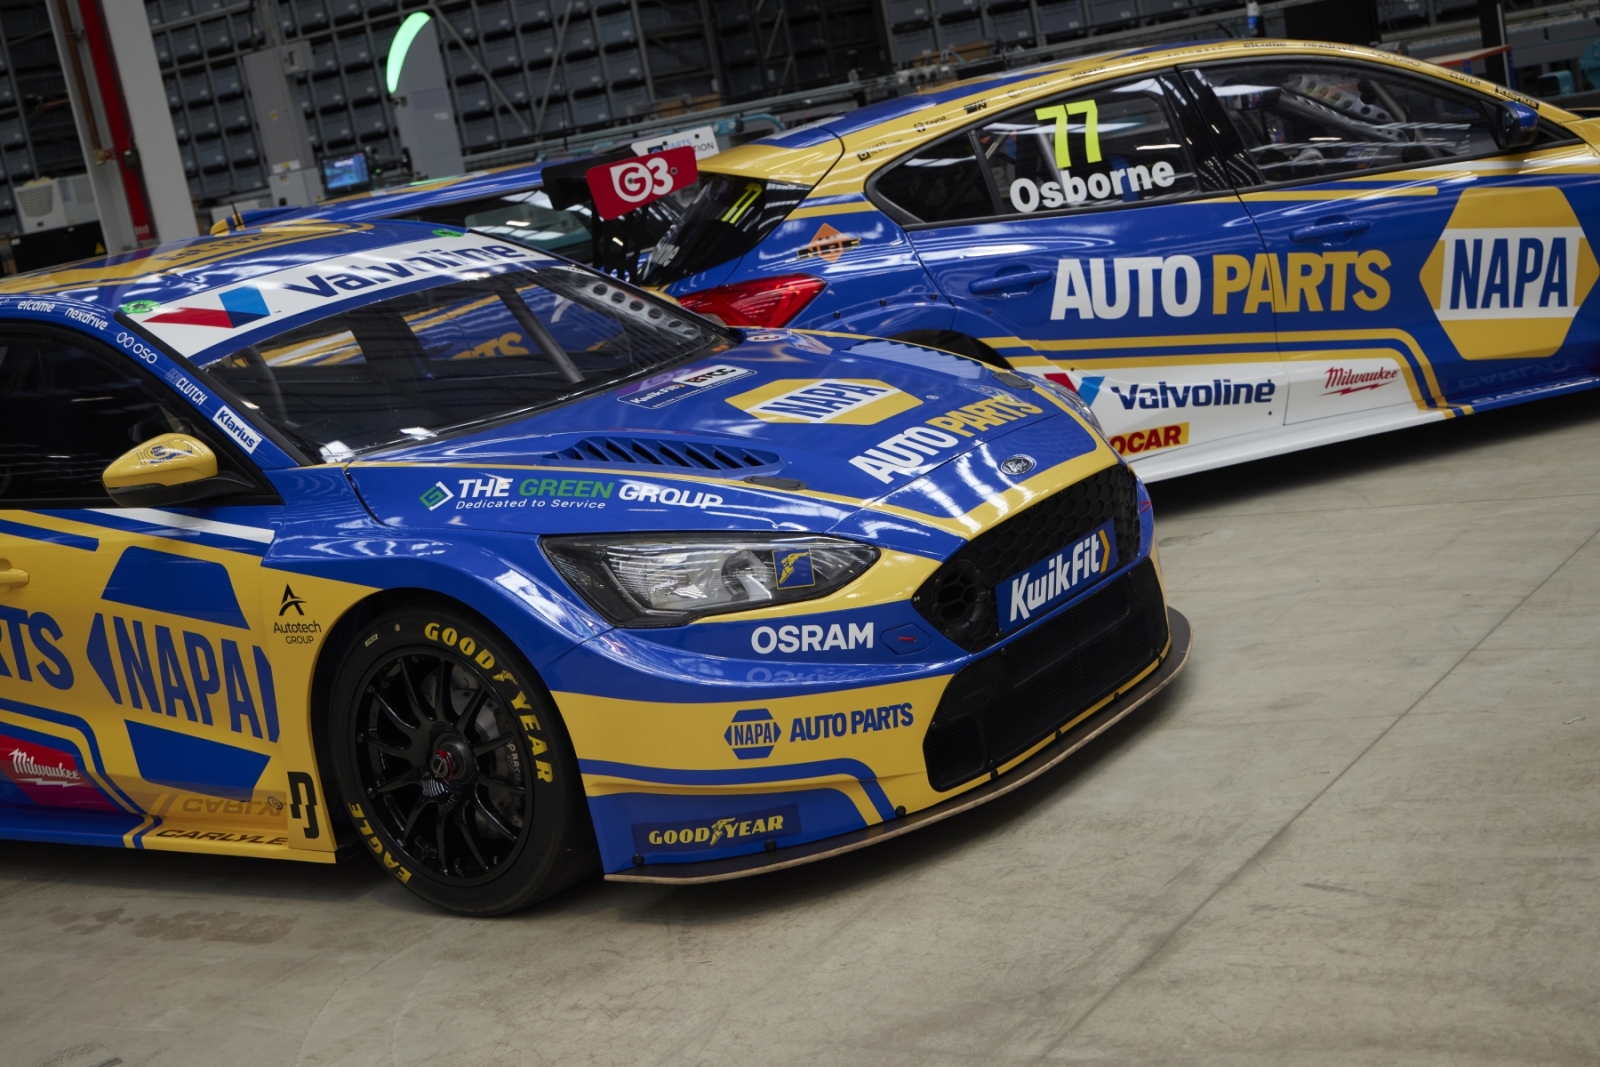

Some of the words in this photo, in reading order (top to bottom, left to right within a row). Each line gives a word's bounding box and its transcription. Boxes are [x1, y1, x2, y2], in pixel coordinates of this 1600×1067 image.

[1034, 99, 1103, 169] 77
[610, 157, 674, 203] G3
[1009, 160, 1176, 213] Osborne
[282, 244, 527, 298] Valvoline
[1050, 254, 1202, 321] AUTO
[1212, 249, 1392, 315] PARTS
[1449, 237, 1568, 310] NAPA
[17, 299, 56, 313] elcome
[64, 307, 109, 331] nexdrive
[1110, 379, 1276, 410] Valvoline
[1323, 366, 1398, 389] Milwaukee
[759, 382, 890, 419] NAPA
[216, 409, 256, 448] Klarius
[848, 426, 959, 485] AUTO
[926, 396, 1044, 438] PARTS
[455, 499, 527, 510] Dedicated
[531, 499, 546, 508] to
[550, 499, 606, 510] Service
[458, 478, 514, 498] THE
[518, 478, 615, 499] GREEN
[618, 483, 724, 509] GROUP
[273, 620, 322, 634] Autotech
[285, 635, 315, 645] GROUP
[751, 622, 874, 654] OSRAM
[112, 615, 264, 740] NAPA
[735, 722, 773, 746] NAPA
[789, 712, 848, 743] AUTO
[851, 702, 914, 735] PARTS
[8, 748, 81, 780] Milwaukee
[156, 829, 289, 846] CARLYLE
[347, 802, 413, 884] EAGLE
